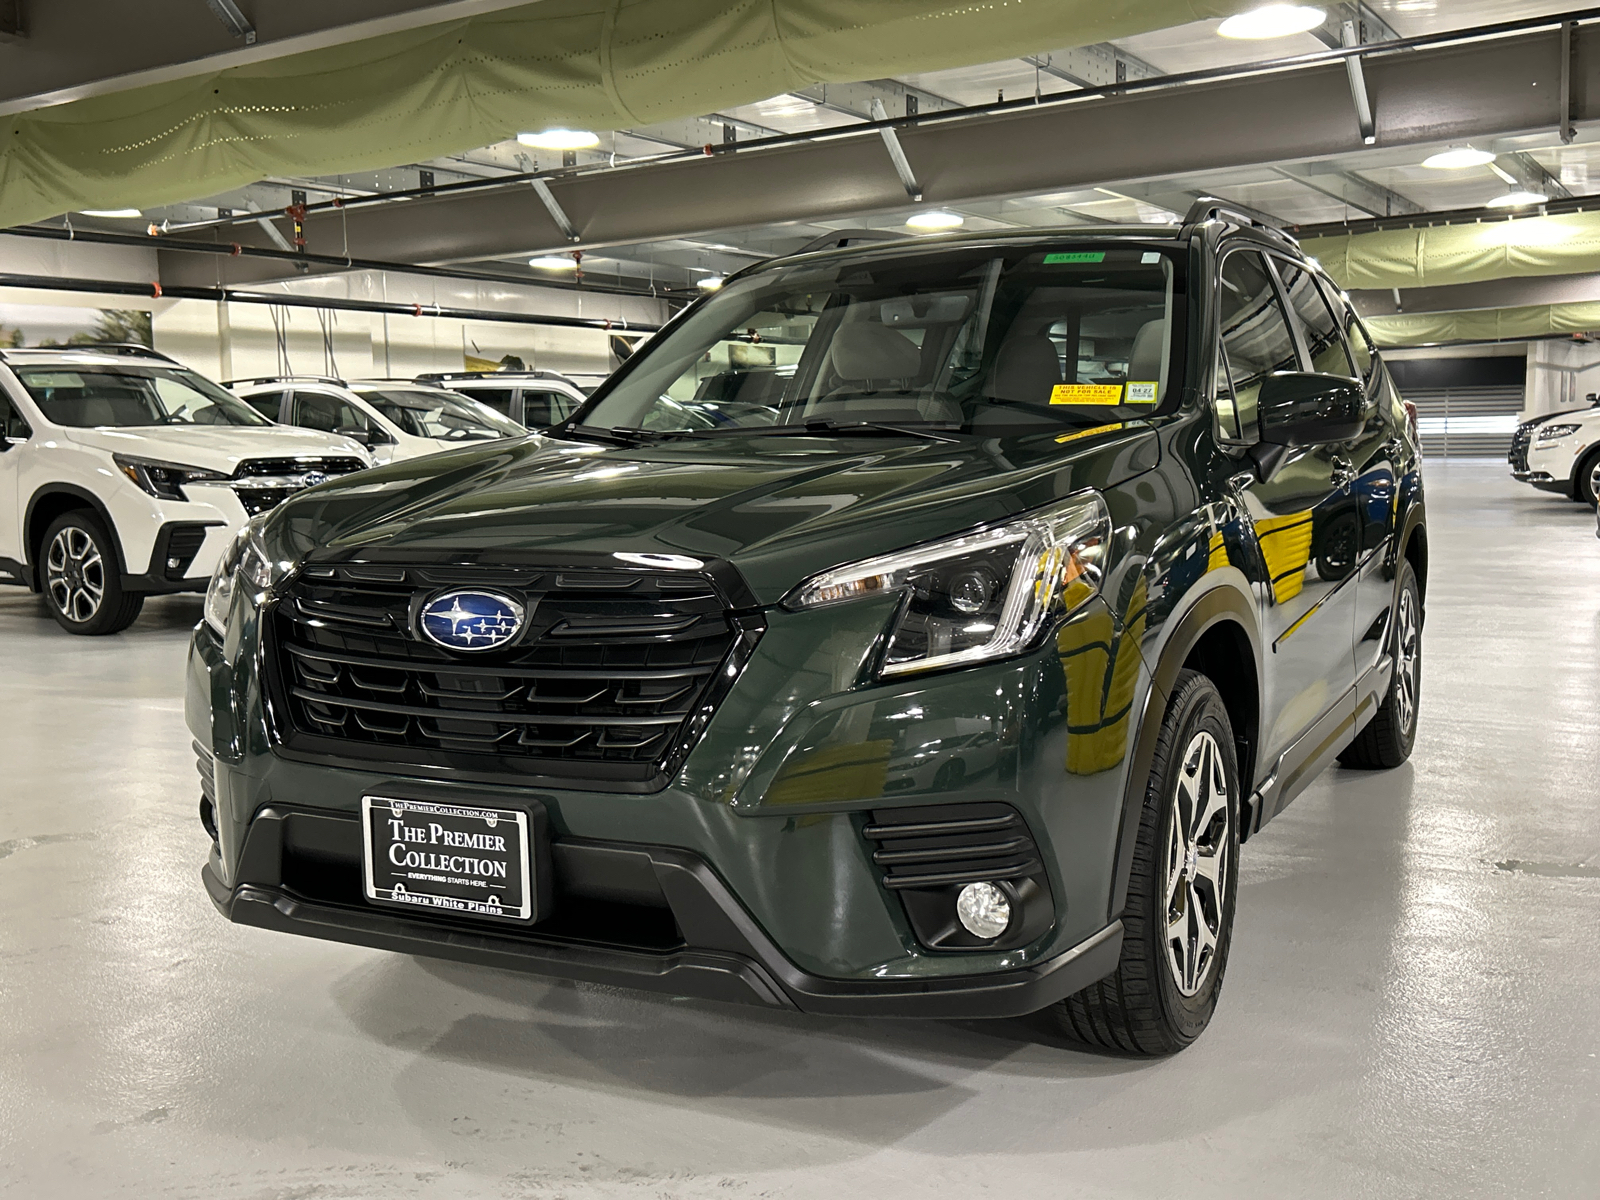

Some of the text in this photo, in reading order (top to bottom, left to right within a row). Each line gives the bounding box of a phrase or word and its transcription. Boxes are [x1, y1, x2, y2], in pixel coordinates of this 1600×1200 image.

[388, 819, 507, 852] THE PREMIER
[388, 843, 507, 878] COLLECTION
[407, 872, 488, 888] EVERYTHING STARTS HERE.
[391, 891, 503, 915] Subaru White Plains
